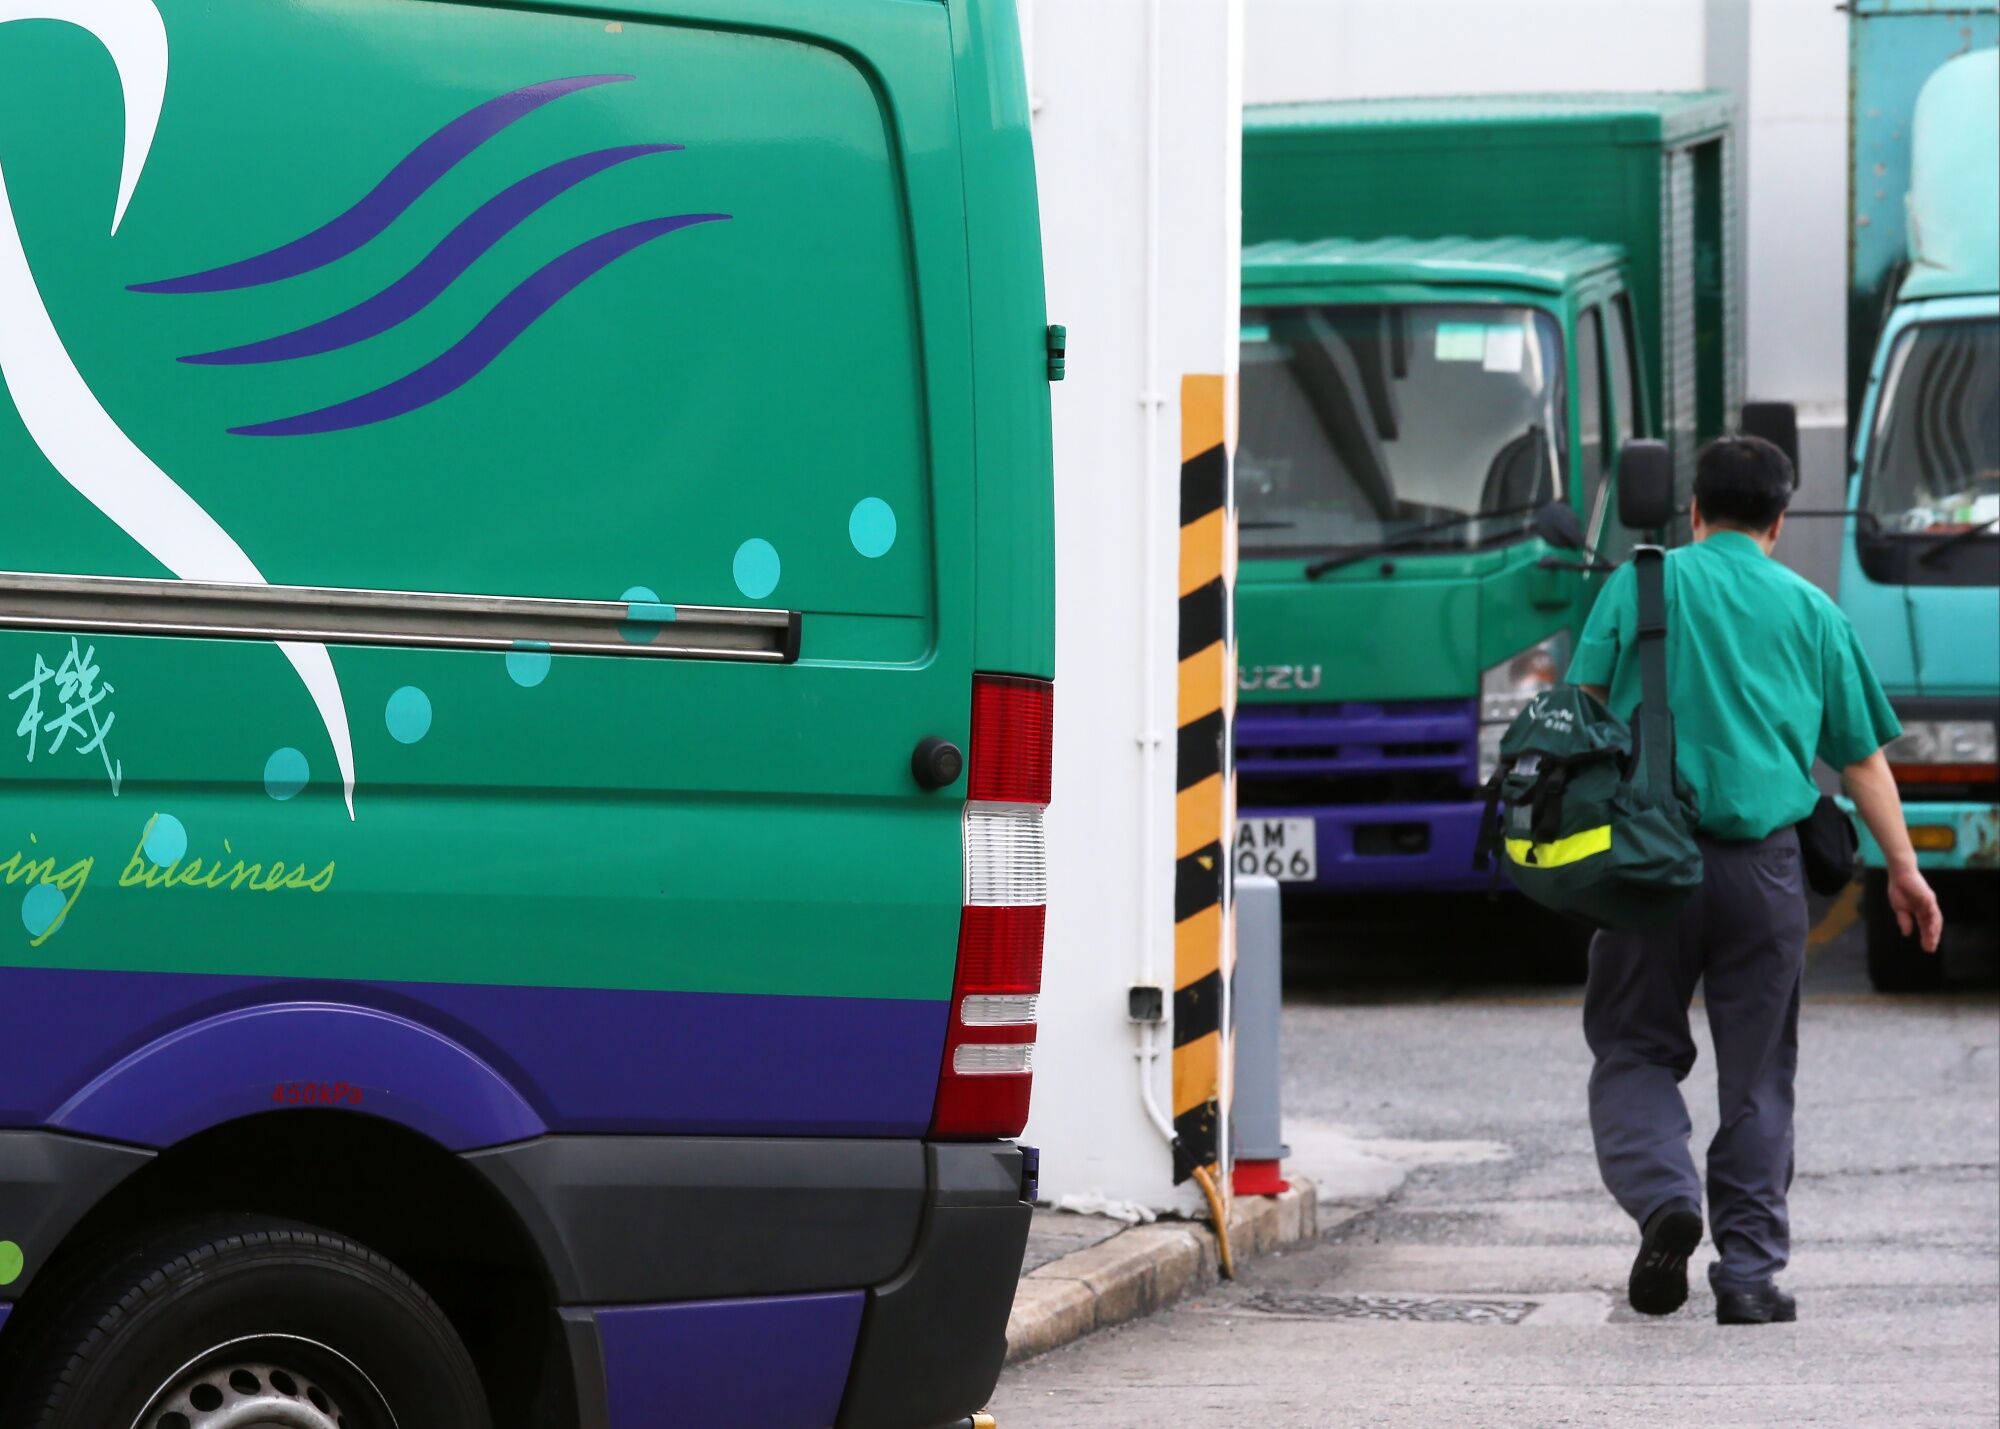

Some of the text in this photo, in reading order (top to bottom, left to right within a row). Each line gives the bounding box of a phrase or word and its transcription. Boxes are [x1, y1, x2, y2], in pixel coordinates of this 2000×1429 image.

[8, 636, 122, 797] 機
[119, 812, 335, 892] business
[1238, 822, 1284, 848] AM
